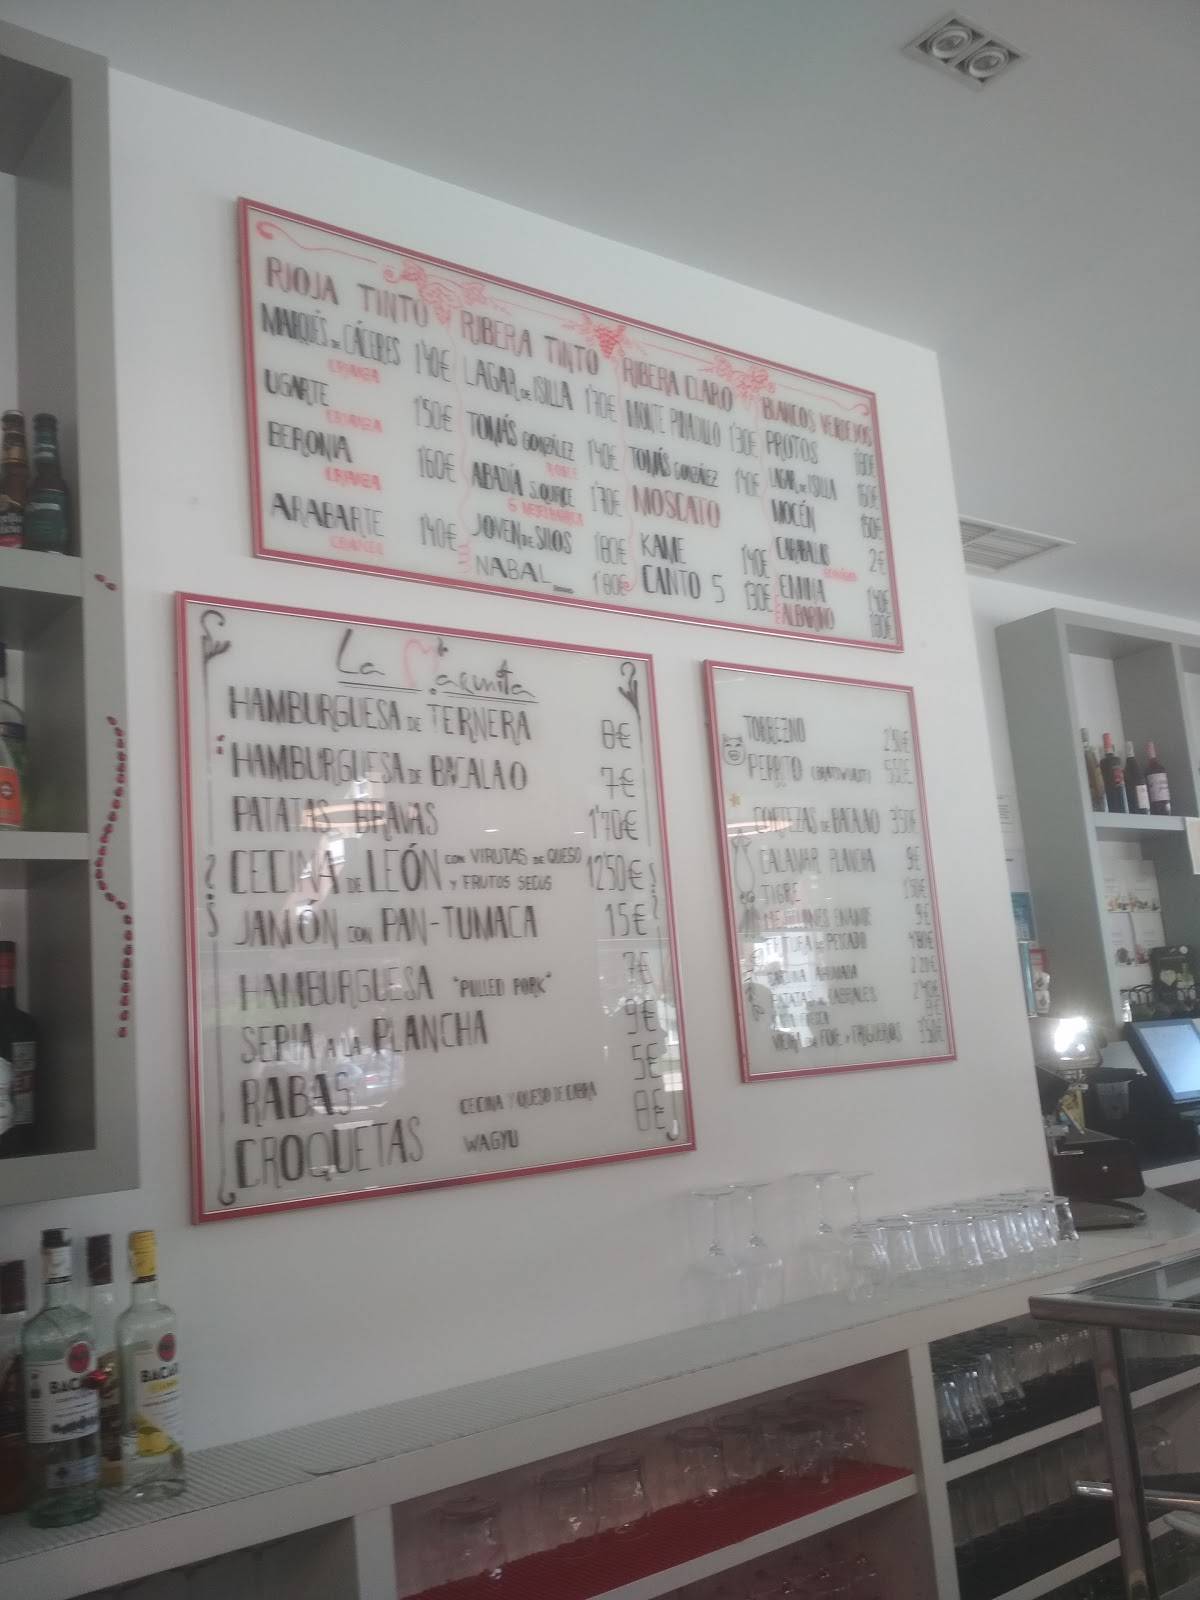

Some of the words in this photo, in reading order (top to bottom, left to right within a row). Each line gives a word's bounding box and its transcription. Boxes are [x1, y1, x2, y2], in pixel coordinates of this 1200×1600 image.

[266, 256, 340, 306] RIOJA
[357, 283, 428, 328] TINTO
[461, 309, 532, 358] RIBERA
[544, 334, 600, 376] TINTO
[464, 358, 520, 402] LAGAR
[623, 357, 681, 397] RIBERA
[684, 375, 733, 413] CLARO
[465, 411, 519, 447] TOMÁS
[762, 396, 817, 434] BLANCOS
[268, 420, 354, 464] BERONIA
[765, 430, 819, 465] PROTOS
[632, 484, 721, 529] MOSCATO
[472, 513, 520, 550] JOVEN
[476, 555, 553, 584] NABAL
[642, 564, 701, 600] CANTO
[711, 574, 727, 604] 5
[336, 628, 386, 677] La
[228, 685, 401, 733] HAMBURGUESA
[407, 716, 422, 733] DE
[426, 703, 532, 746] TERNERA
[601, 719, 632, 750] 8€
[232, 741, 404, 787] HAMBURGUESA
[601, 766, 635, 799] 7€
[233, 794, 335, 834] PATATAS
[353, 800, 439, 842] BRAVAS
[231, 846, 340, 895] CECINA
[366, 842, 442, 893] LEÓN
[469, 847, 528, 866] VIRUTAS
[462, 874, 512, 890] FRUTOS
[234, 899, 340, 951] JAMÓN
[605, 902, 649, 937] 15€
[240, 964, 436, 1012] HAMBURGUESA
[241, 1022, 316, 1064] SEPIA
[373, 1010, 488, 1056] PLANCHA
[242, 1071, 352, 1128] RABAS
[631, 1042, 662, 1080] 5€
[236, 1116, 424, 1191] CROQUETAS
[464, 1129, 519, 1152] WAGYU
